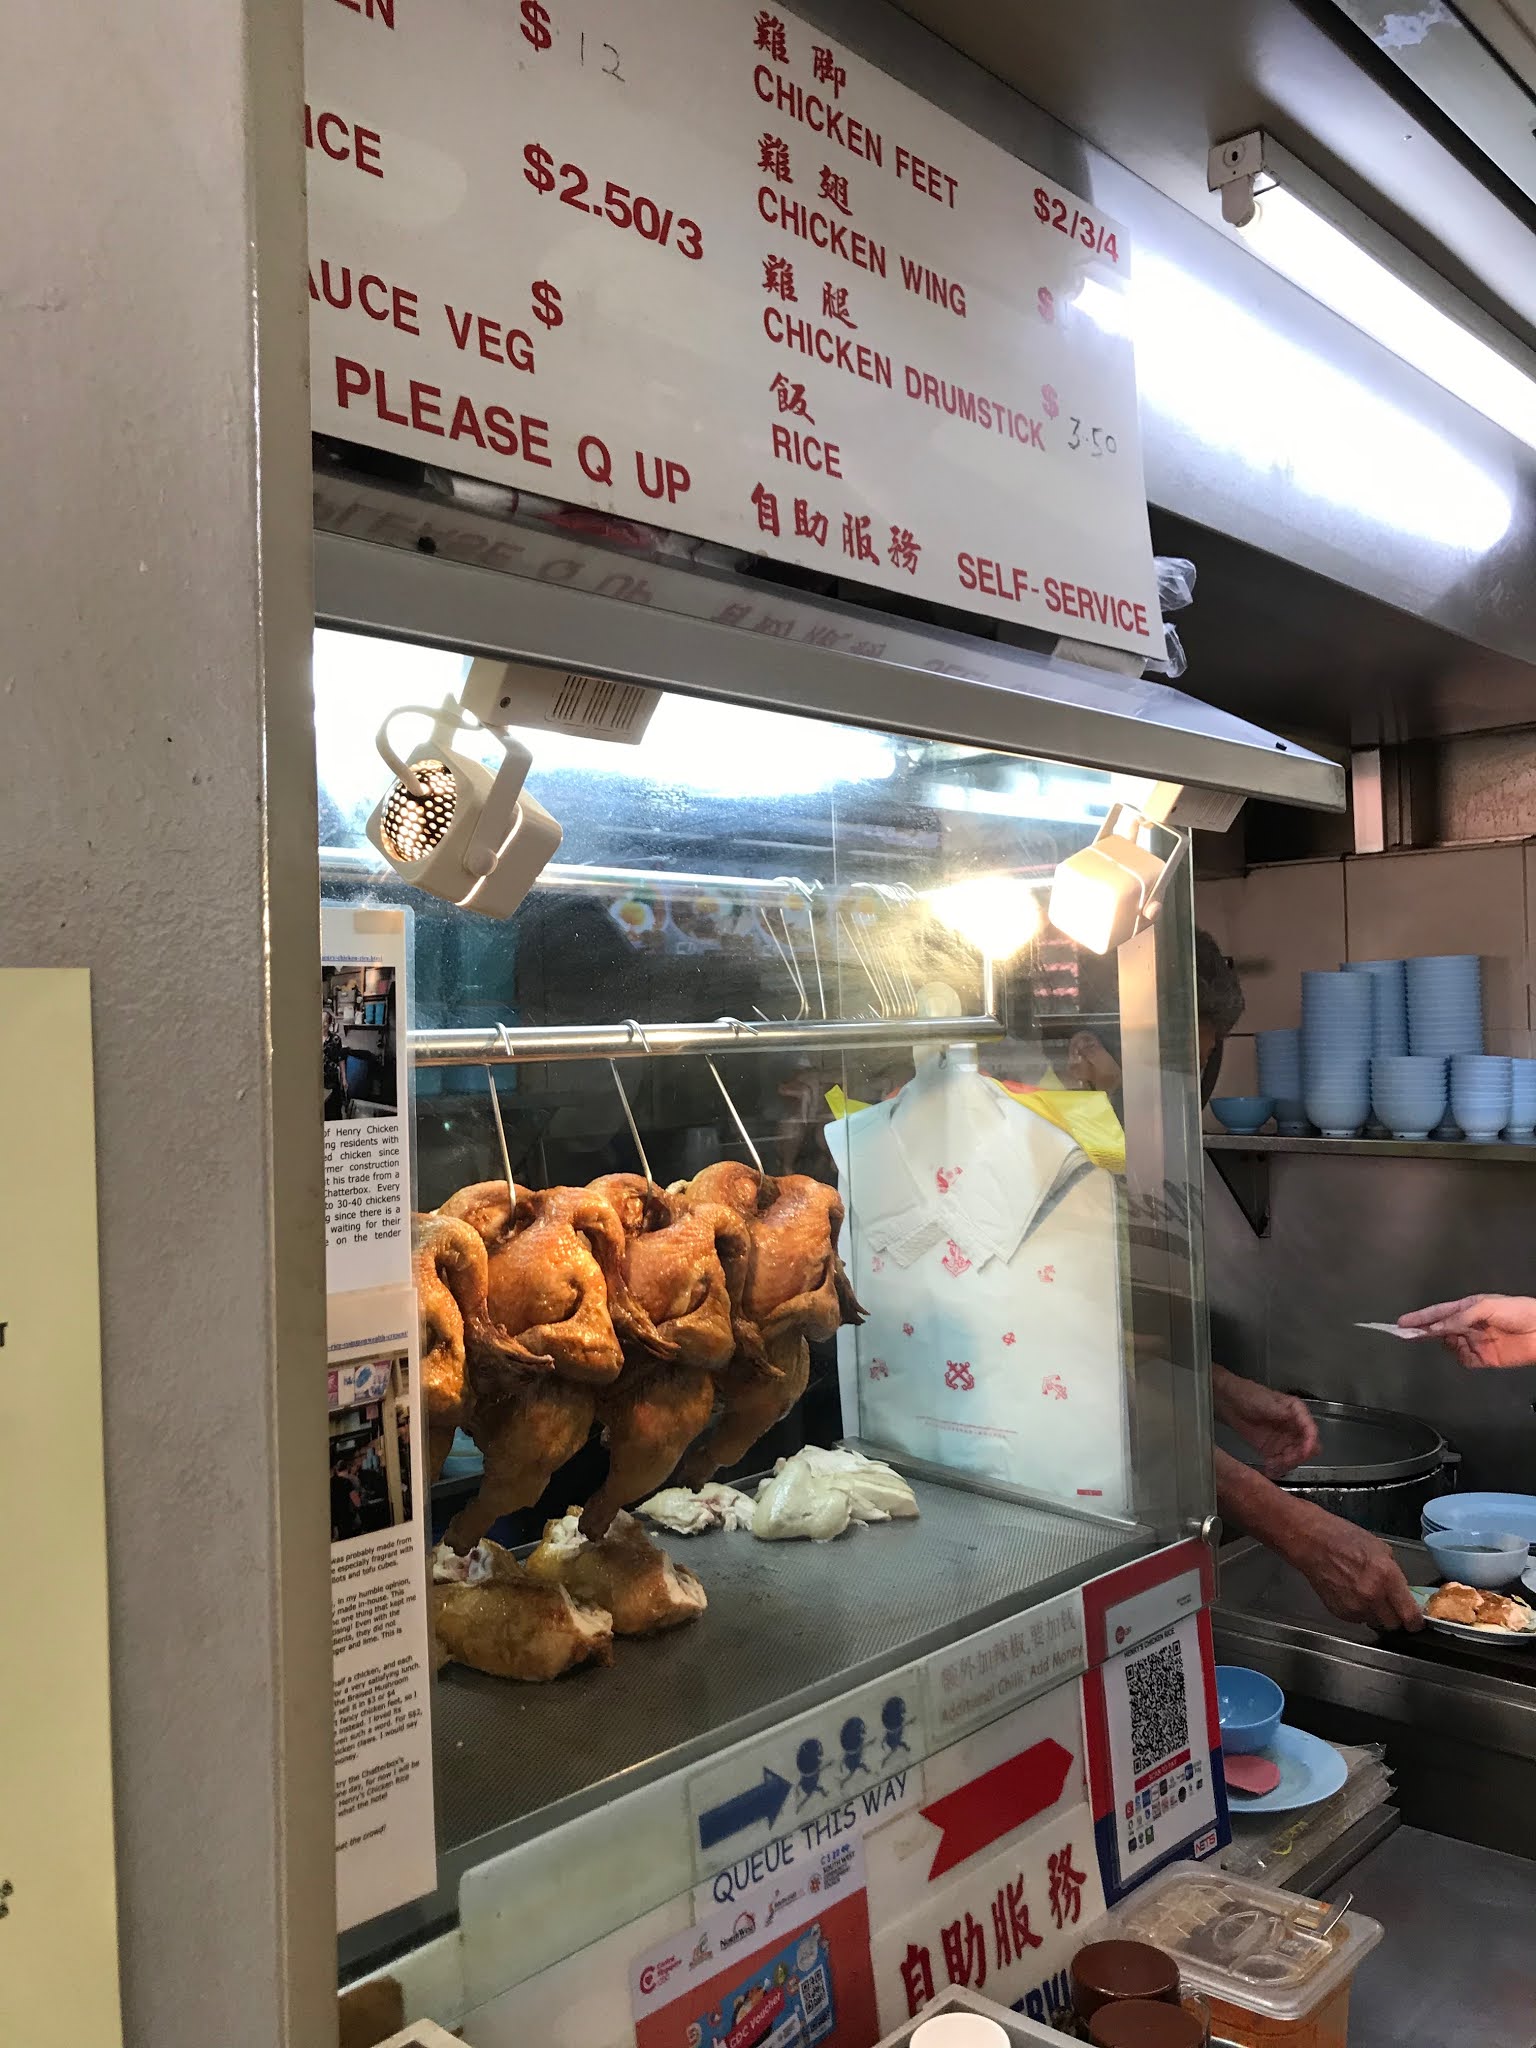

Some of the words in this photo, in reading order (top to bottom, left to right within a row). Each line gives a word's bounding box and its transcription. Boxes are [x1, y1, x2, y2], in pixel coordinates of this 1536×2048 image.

[521, 0, 552, 51] $
[581, 32, 626, 82] 12
[754, 64, 882, 168] CHICKEN
[896, 145, 958, 209] FEET
[523, 143, 704, 260] $2.50/3
[1033, 187, 1119, 263] $2/3/4
[758, 186, 886, 279] CHICKEN
[900, 255, 966, 318] WING
[531, 280, 564, 330] $
[1037, 286, 1054, 324] $
[445, 304, 535, 374] VEG
[764, 306, 892, 389] CHICKEN
[905, 365, 1045, 451] DRUMSTICK
[1041, 383, 1059, 420] $
[335, 356, 553, 468] PLEASE
[577, 435, 614, 487] Q
[635, 451, 692, 503] UP
[772, 423, 843, 479] RICE
[750, 482, 922, 576] 自助服務
[958, 554, 1150, 637] SELF-SERVICE
[336, 1128, 361, 1136] Henry
[367, 1124, 399, 1134] Chicken
[340, 1138, 378, 1148] residents
[382, 1136, 399, 1144] with
[340, 1150, 371, 1160] chicken
[379, 1148, 400, 1156] since
[349, 1160, 400, 1171] construction
[348, 1174, 370, 1183] trade
[373, 1172, 391, 1180] from
[377, 1183, 400, 1192] Every
[335, 1211, 356, 1221] since
[360, 1208, 382, 1218] there
[386, 1206, 392, 1214] is
[337, 1198, 362, 1208] 30-40
[366, 1194, 400, 1205] chickens
[331, 1223, 360, 1233] waiting
[366, 1220, 377, 1228] for
[382, 1218, 401, 1226] their
[336, 1237, 347, 1245] on
[354, 1233, 368, 1242] the
[375, 1229, 401, 1240] tender
[337, 1558, 369, 1573] especially
[372, 1550, 397, 1562] fragrant
[400, 1545, 414, 1554] with
[346, 1547, 374, 1562] probably
[376, 1541, 395, 1552] made
[397, 1537, 411, 1546] from
[348, 1570, 361, 1580] and
[362, 1566, 376, 1575] tofu
[377, 1560, 398, 1571] cubes.
[337, 1597, 344, 1605] in
[346, 1594, 357, 1602] my
[359, 1586, 383, 1598] humble
[385, 1578, 411, 1590] opinion,
[337, 1604, 356, 1615] made
[358, 1595, 388, 1608] in-house.
[391, 1589, 404, 1598] This
[341, 1614, 354, 1623] one
[356, 1609, 373, 1618] thing
[374, 1603, 388, 1612] that
[390, 1598, 404, 1608] kept
[355, 1619, 371, 1628] Even
[374, 1613, 387, 1622] with
[389, 1609, 400, 1617] the
[348, 1640, 361, 1650] and
[381, 1630, 395, 1639] This
[356, 1629, 371, 1638] they
[373, 1624, 383, 1633] did
[385, 1620, 396, 1628] not
[1144, 1634, 1163, 1649] CHICKEN
[1164, 1627, 1175, 1638] RICE
[354, 1667, 381, 1680] chicken,
[383, 1660, 396, 1670] and
[397, 1655, 412, 1666] each
[1030, 1655, 1049, 1679] Add
[1052, 1644, 1083, 1668] Money
[348, 1687, 372, 1702] Braised
[375, 1676, 409, 1692] Mushroom
[351, 1681, 365, 1691] very
[368, 1670, 399, 1685] satisfying
[361, 1703, 386, 1717] chicken
[713, 1835, 795, 1904] QUEUE
[801, 1801, 857, 1850] THIS
[862, 1771, 907, 1817] WAY
[1195, 1833, 1216, 1853] NETS
